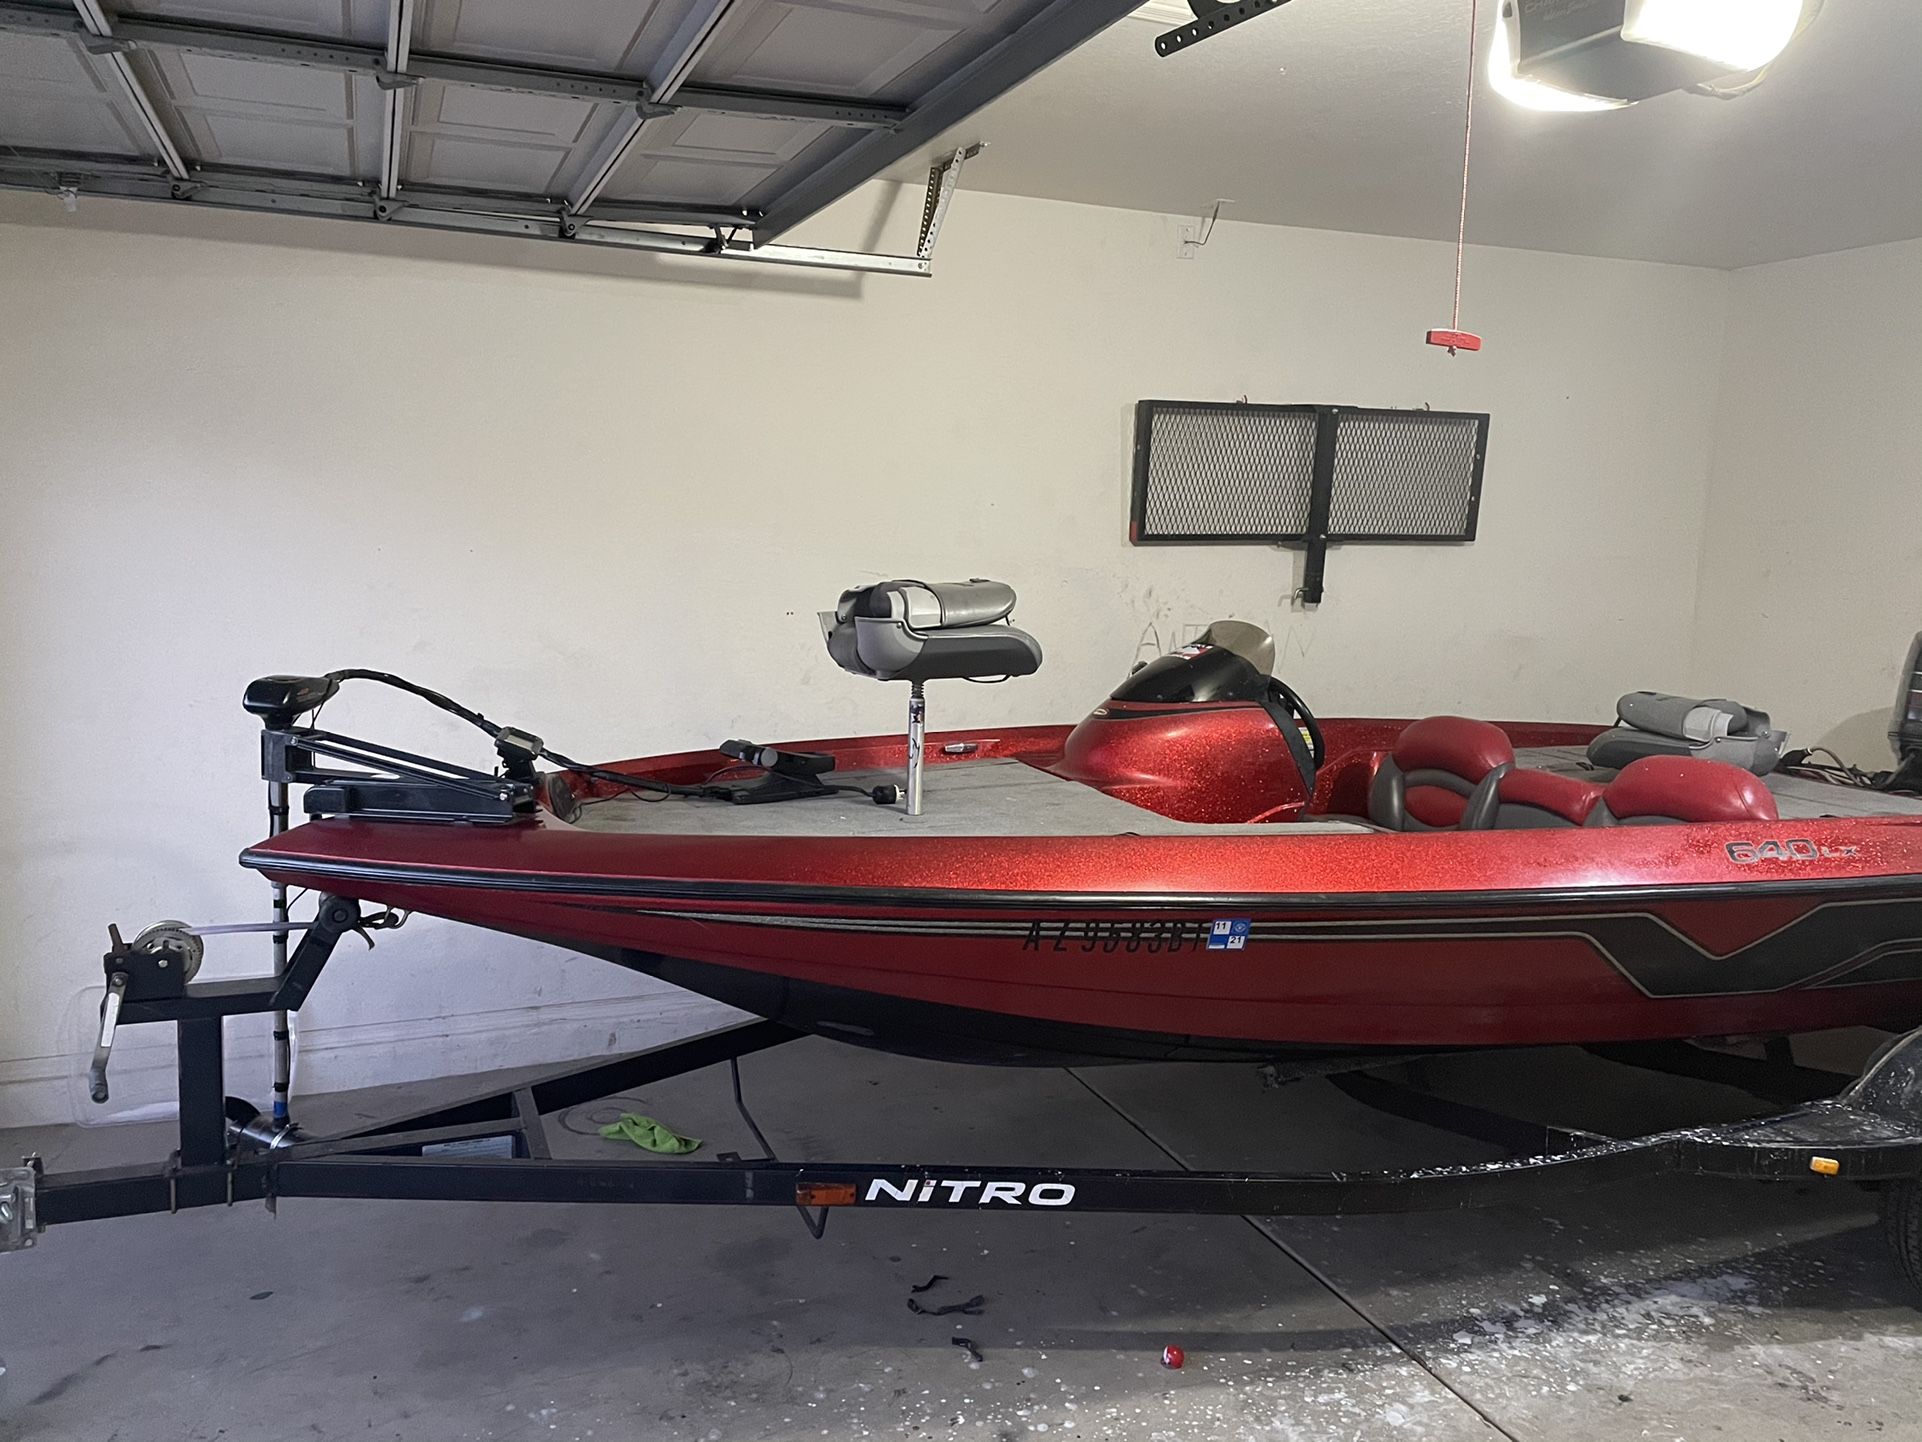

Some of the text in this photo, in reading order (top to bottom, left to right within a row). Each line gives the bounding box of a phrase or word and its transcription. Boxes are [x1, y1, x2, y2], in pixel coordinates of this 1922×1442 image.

[1725, 838, 1819, 863] 640
[1216, 922, 1226, 930] 11
[1230, 936, 1241, 944] 21
